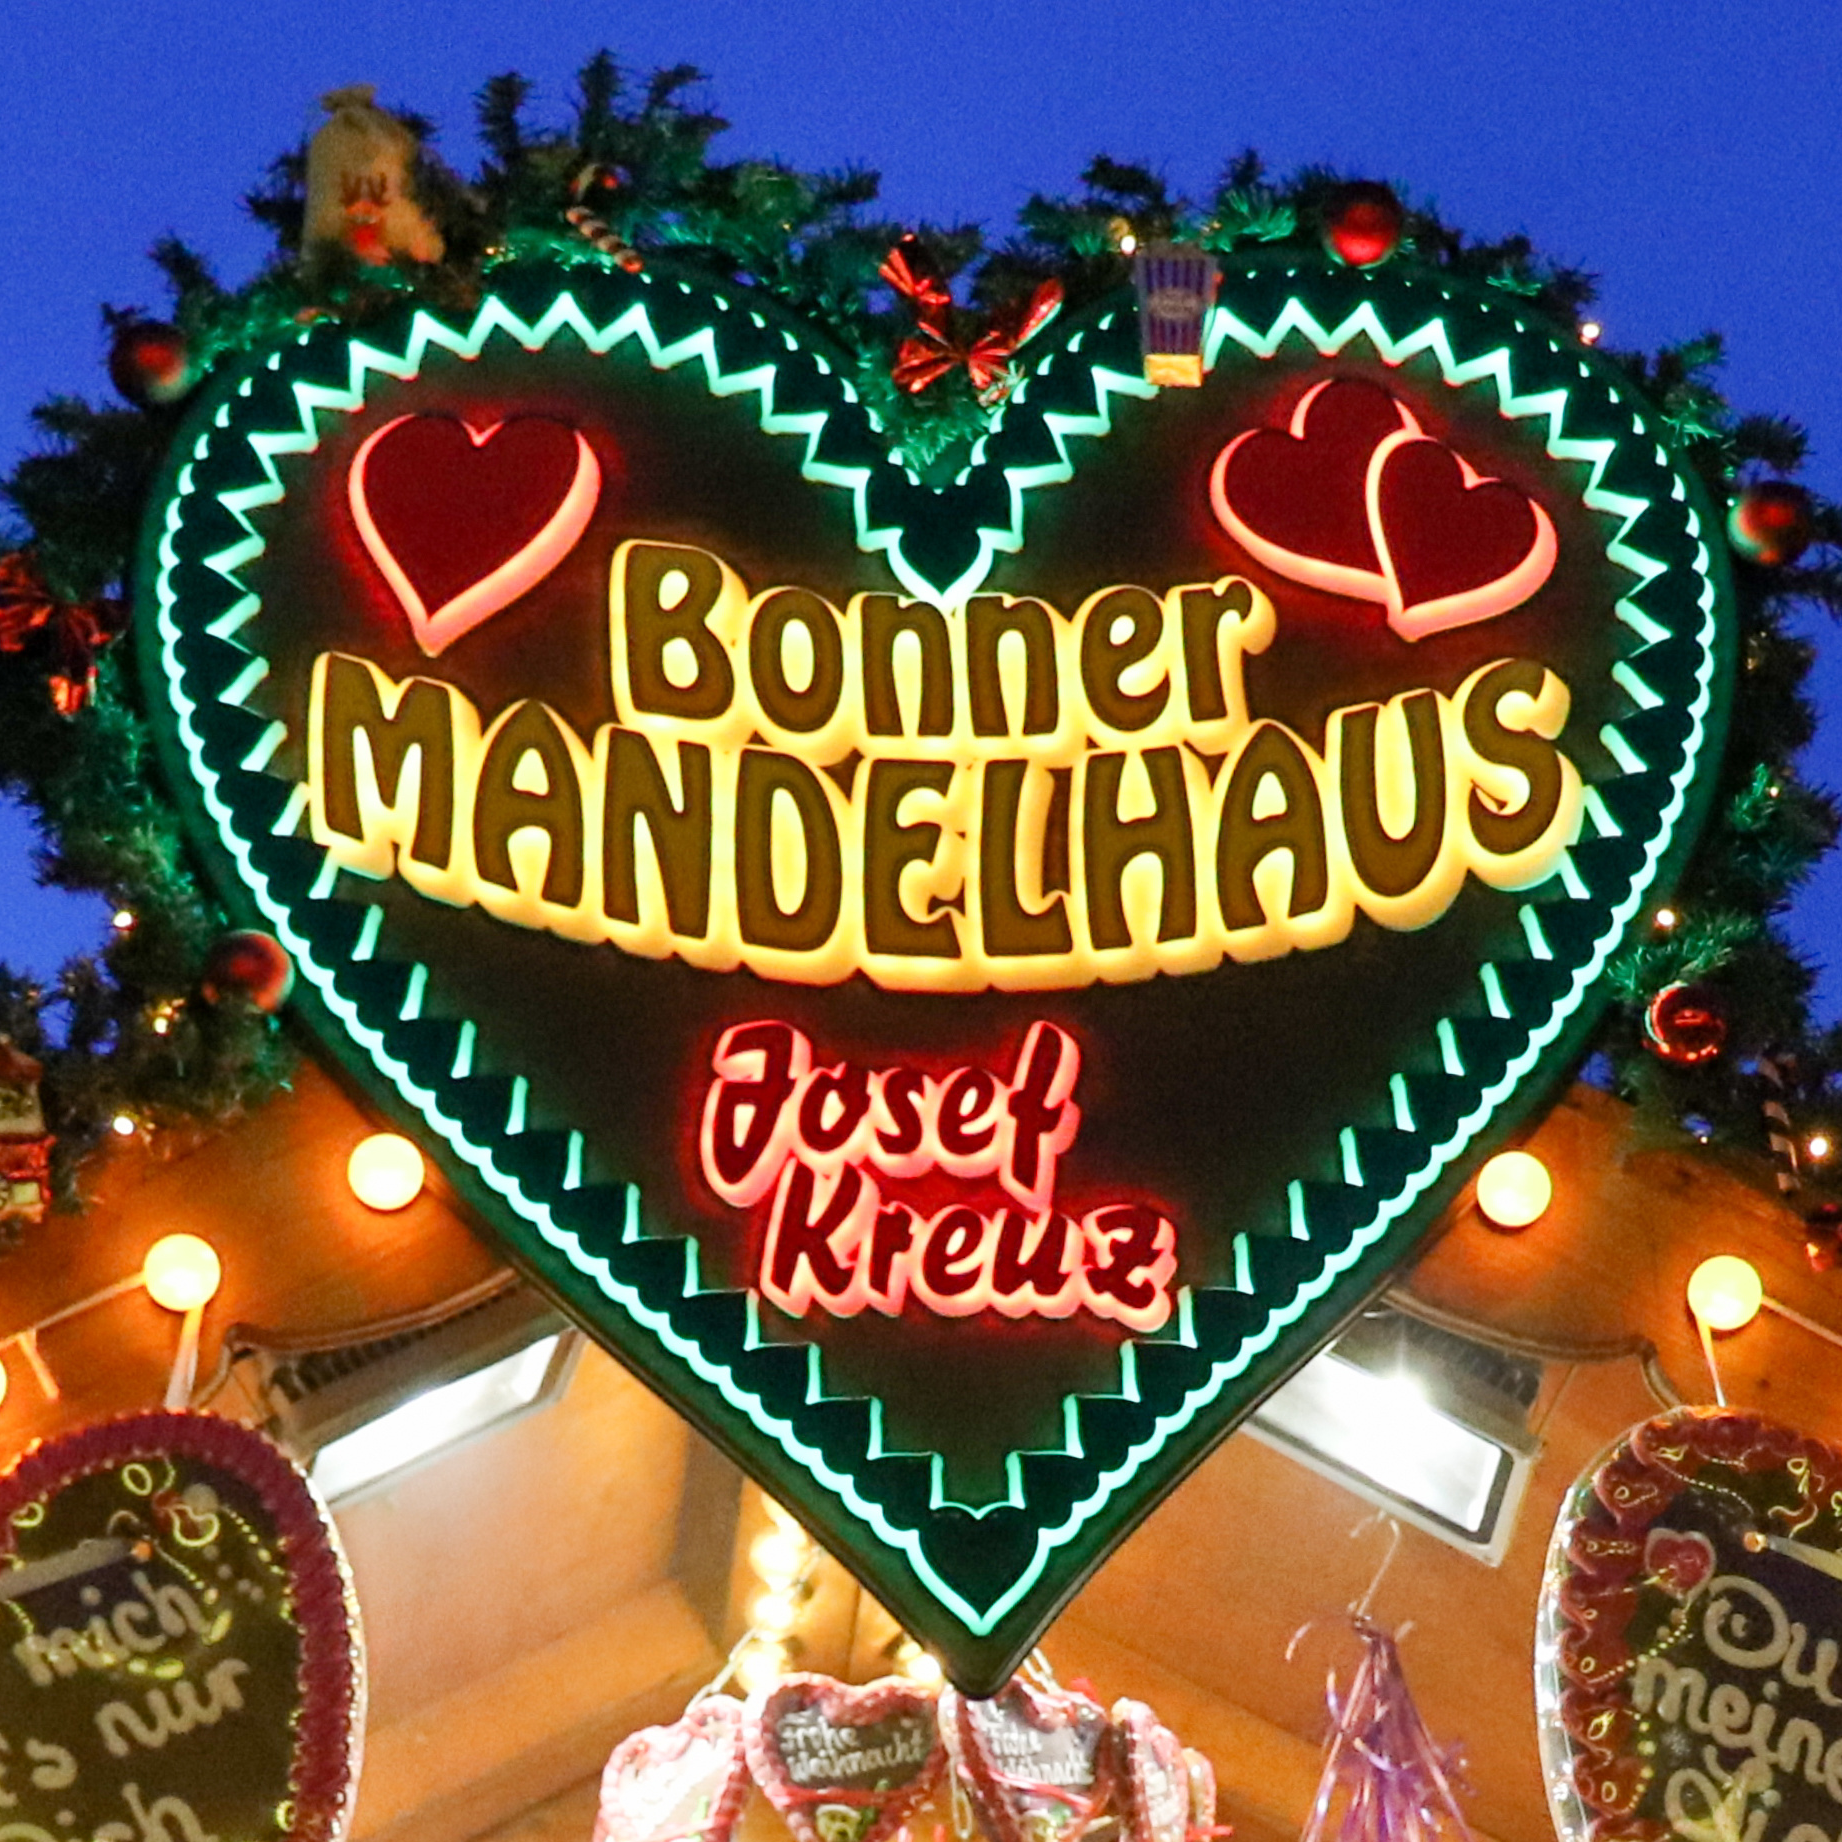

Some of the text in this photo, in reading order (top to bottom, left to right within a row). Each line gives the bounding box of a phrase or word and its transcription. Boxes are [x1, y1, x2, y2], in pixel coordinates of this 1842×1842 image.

[612, 538, 1276, 762] Bonner
[309, 648, 1585, 990] MANDELHAUS
[700, 1020, 1085, 1208] Josef
[763, 1163, 1177, 1332] Kreuz
[14, 1572, 210, 1686] mich
[94, 1659, 250, 1757] nur
[780, 1709, 859, 1752] Frohe
